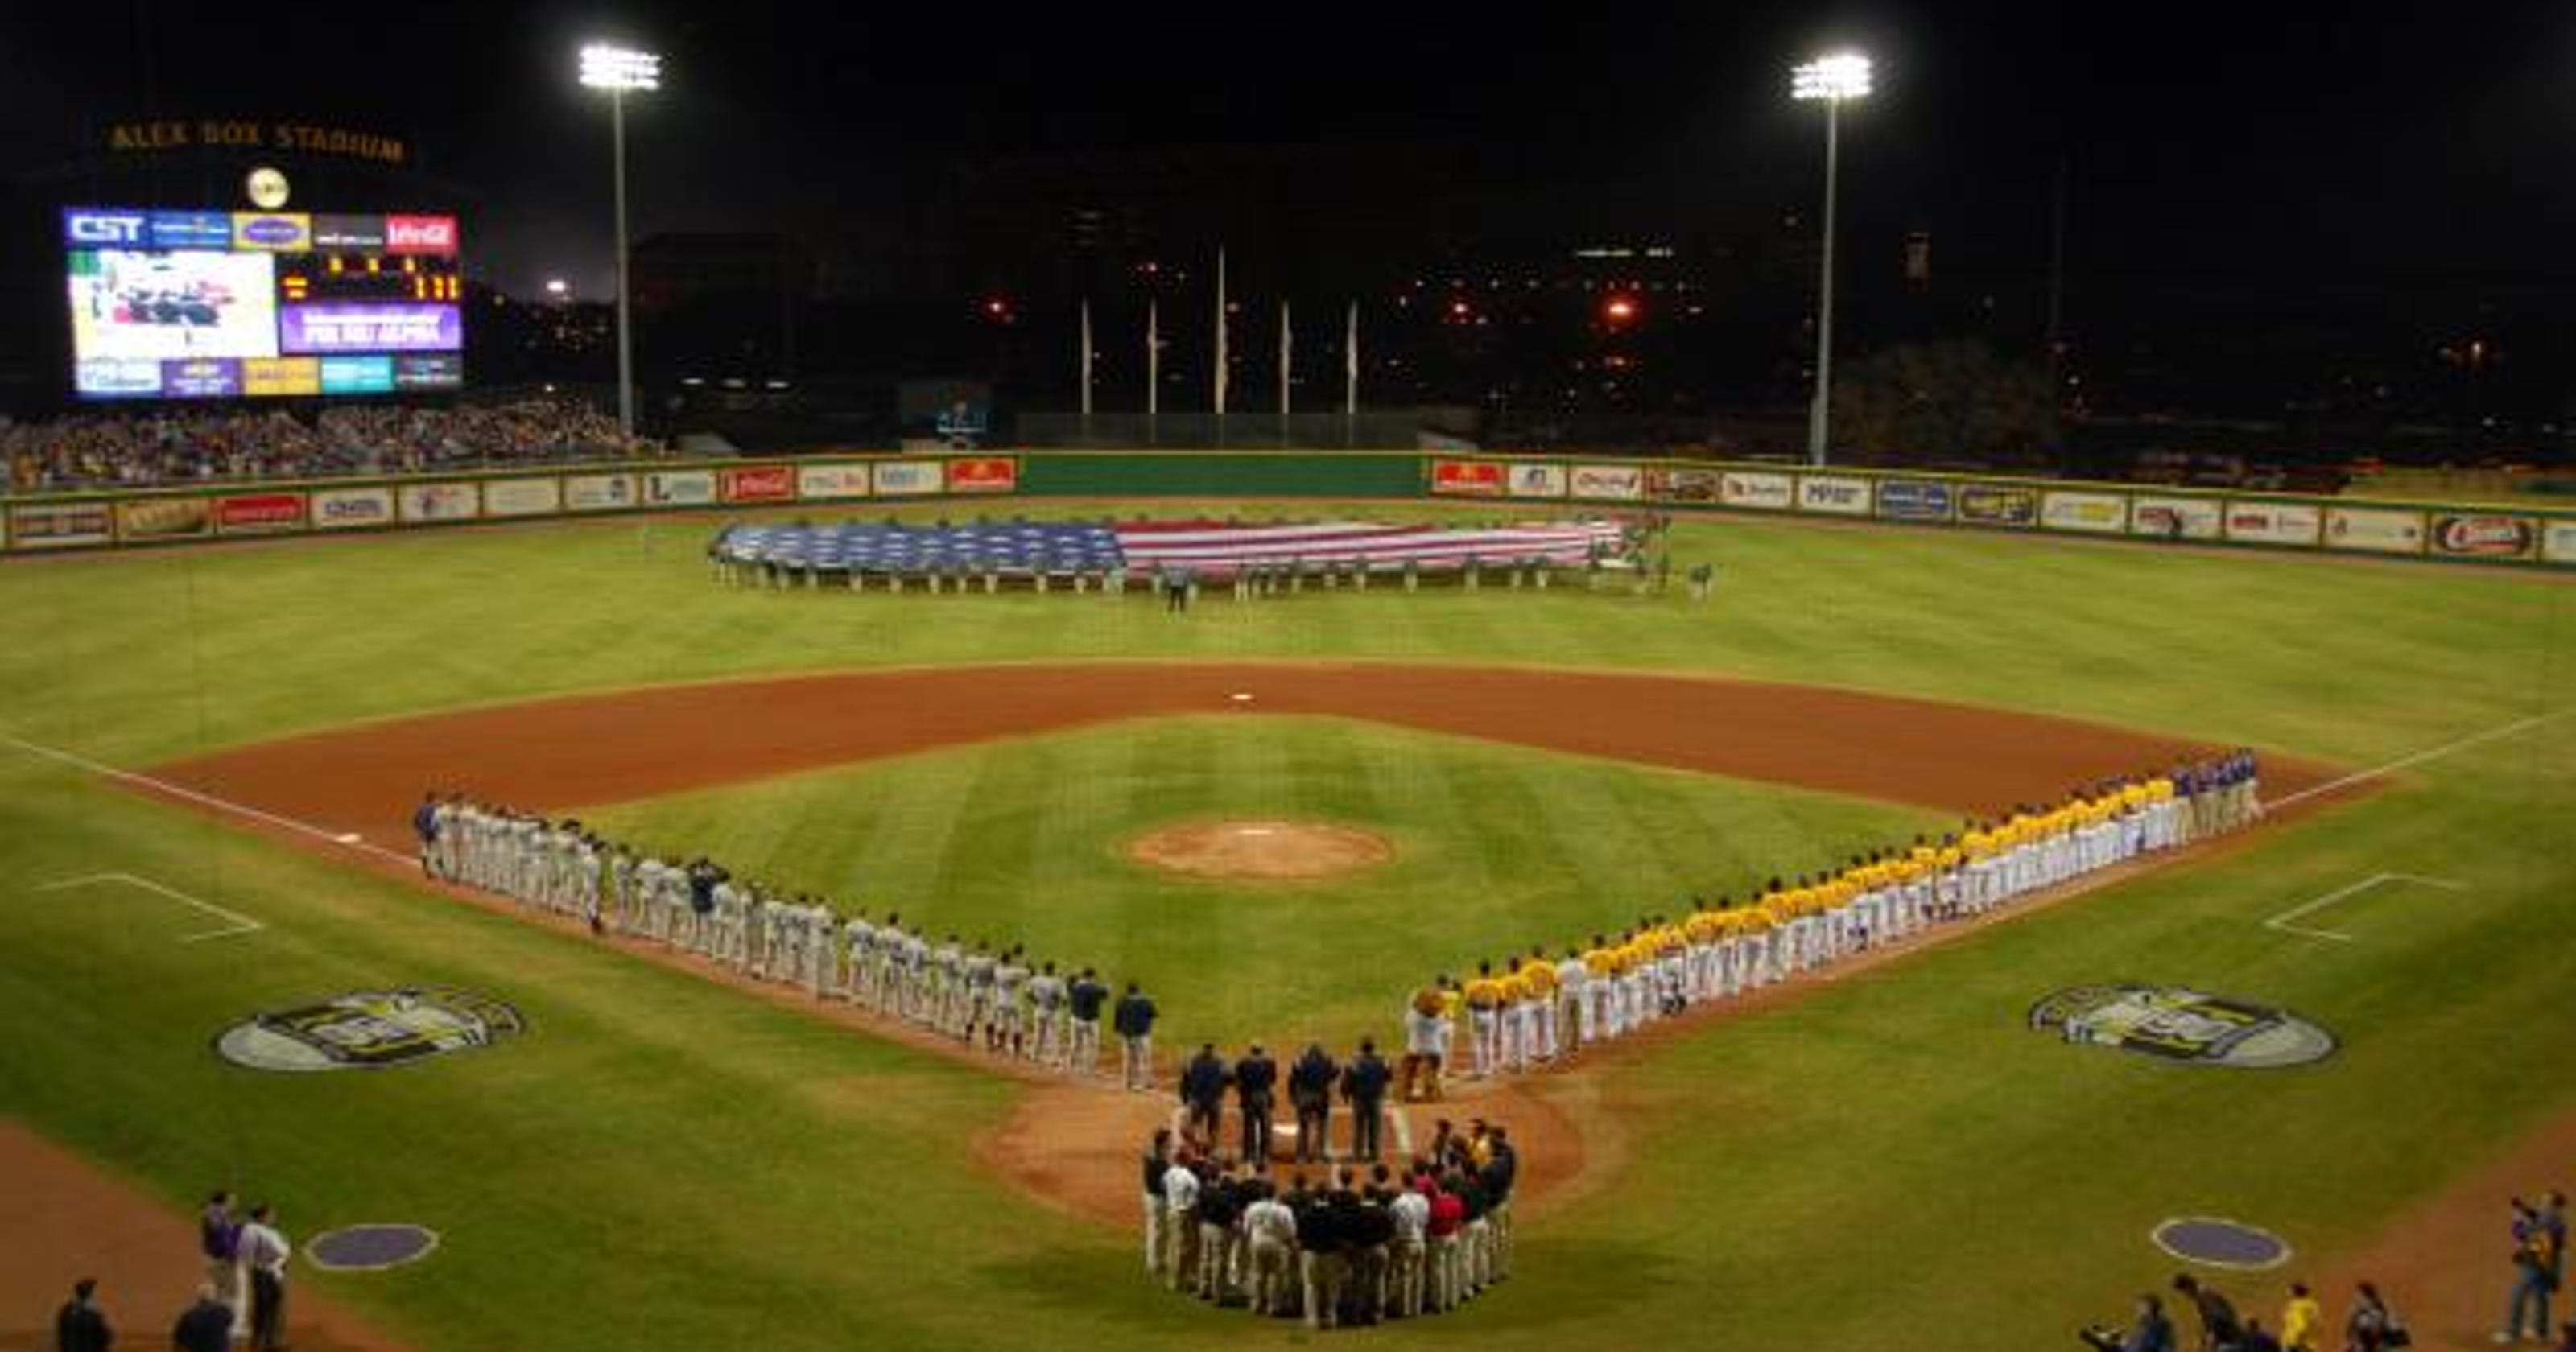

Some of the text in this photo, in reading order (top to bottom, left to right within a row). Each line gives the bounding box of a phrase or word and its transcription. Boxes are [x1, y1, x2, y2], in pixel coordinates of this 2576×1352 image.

[110, 122, 405, 161] ALEX BOX STADIUM
[72, 216, 144, 241] CST
